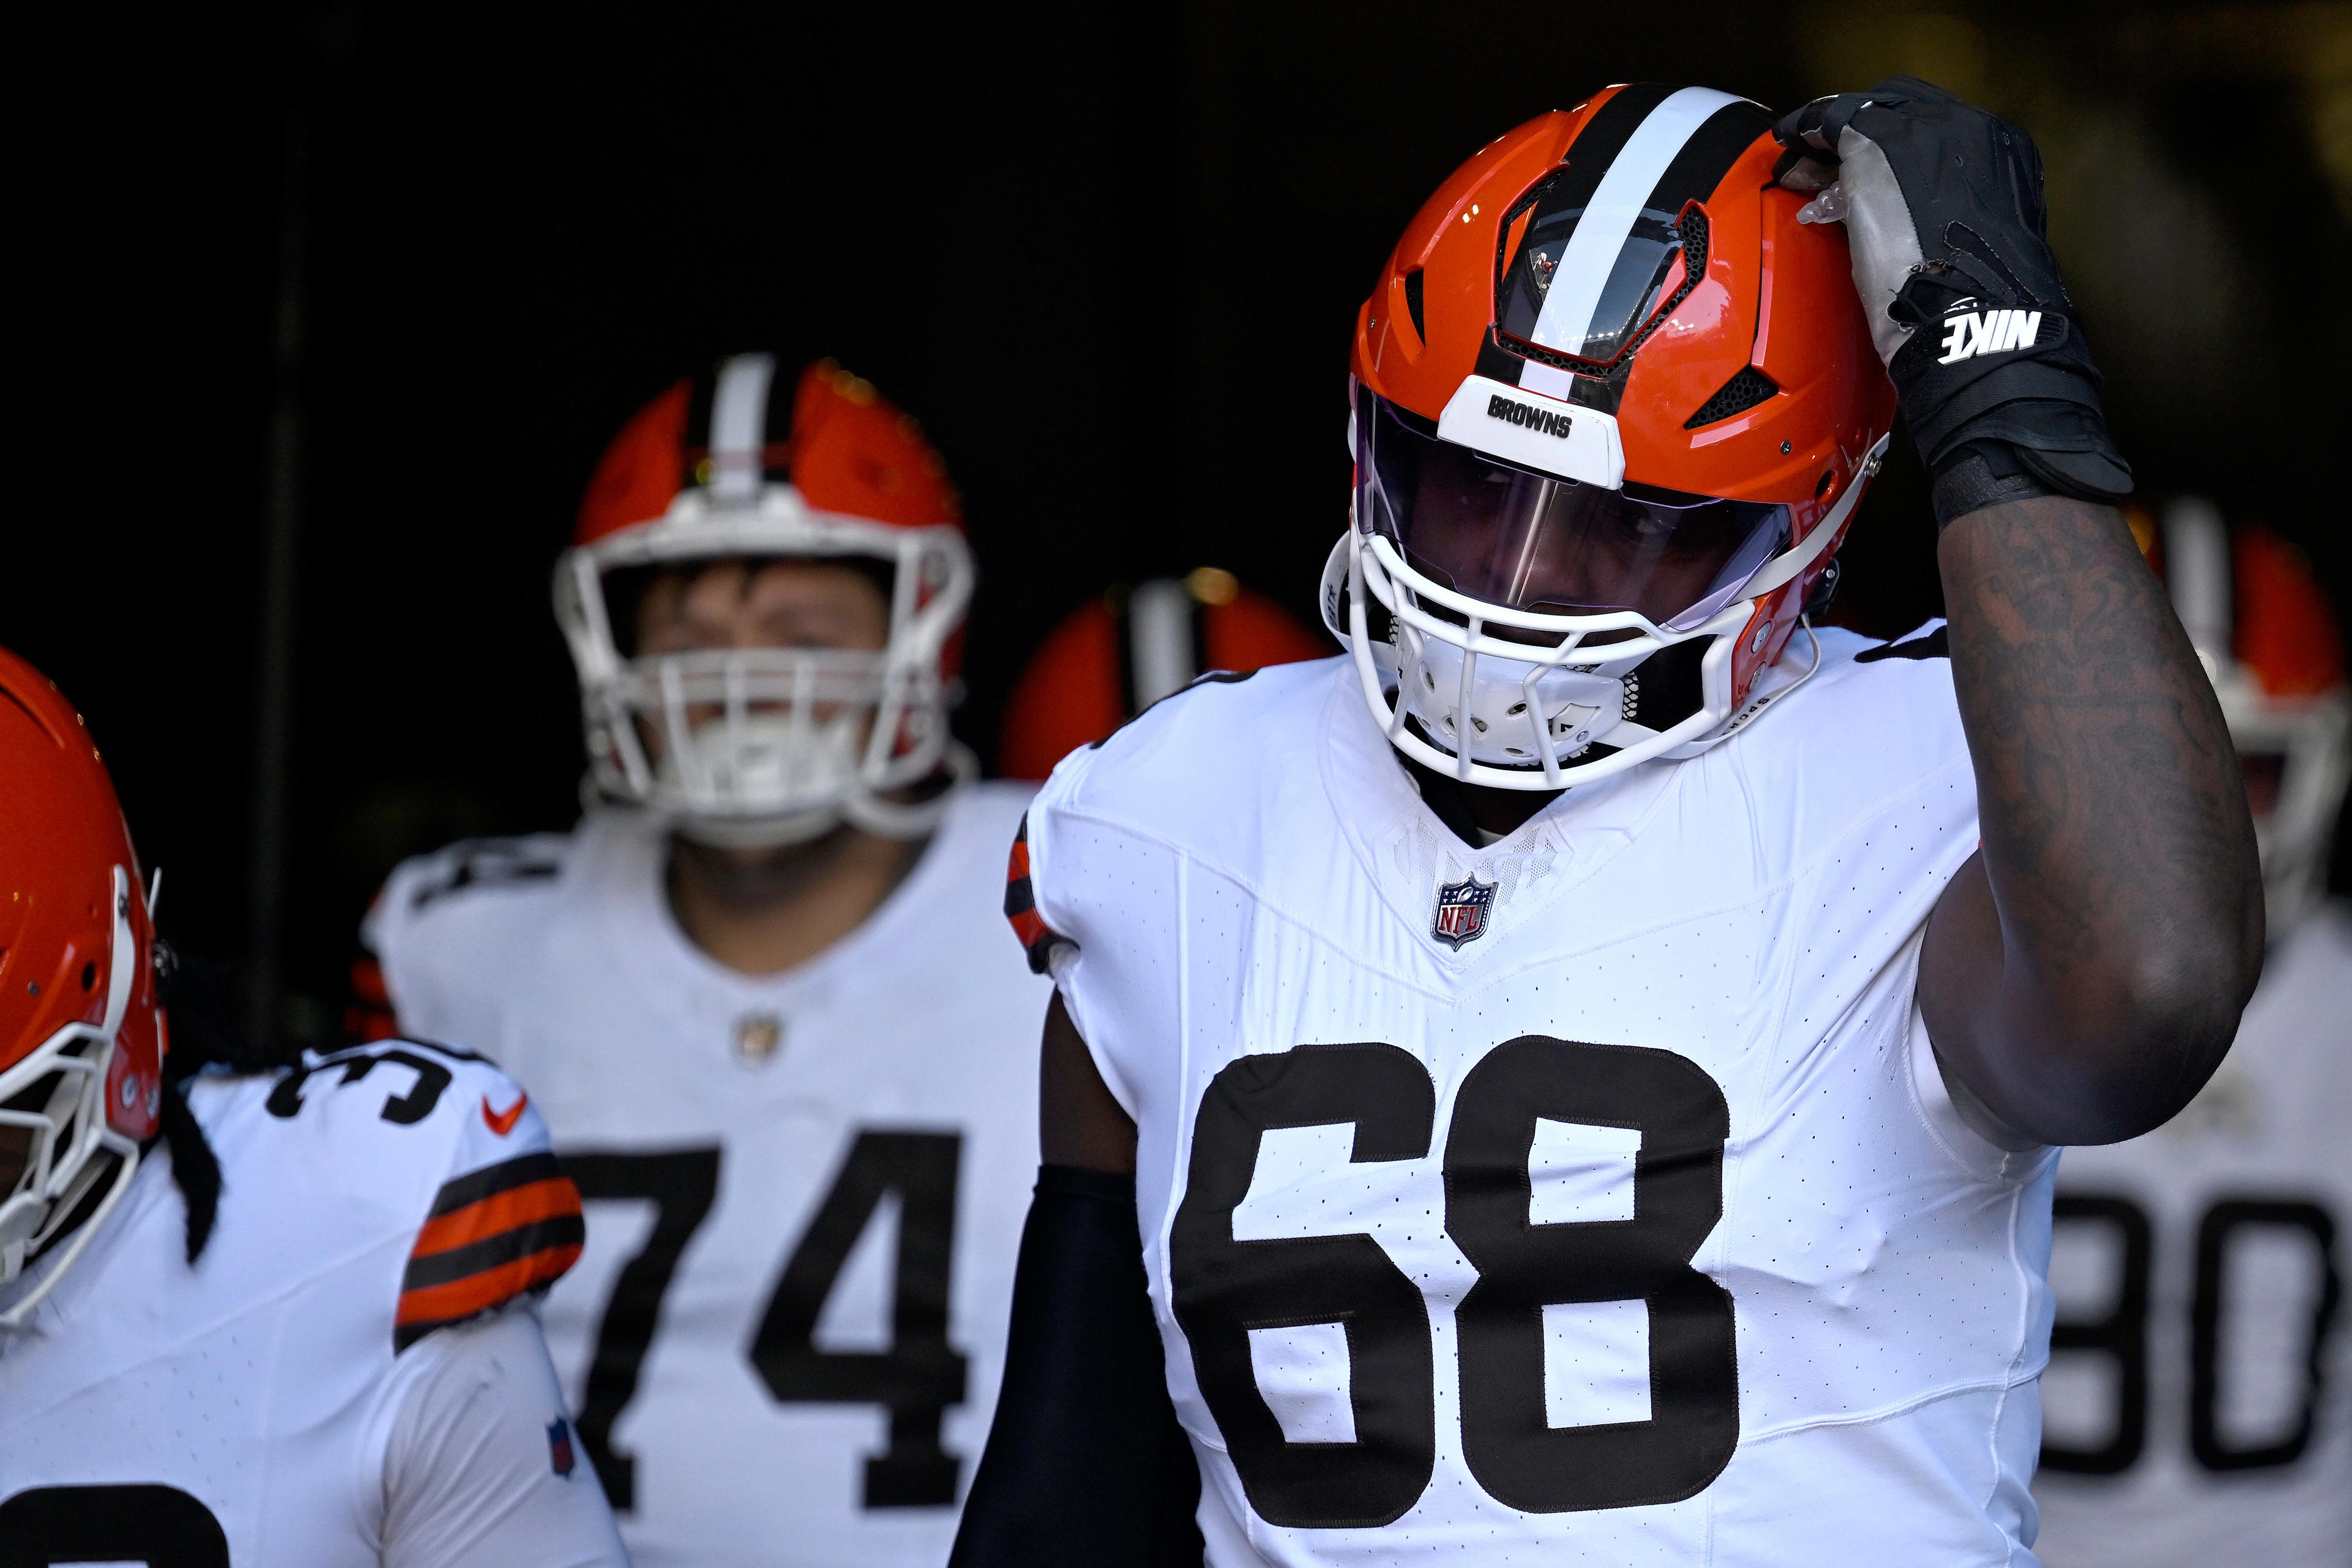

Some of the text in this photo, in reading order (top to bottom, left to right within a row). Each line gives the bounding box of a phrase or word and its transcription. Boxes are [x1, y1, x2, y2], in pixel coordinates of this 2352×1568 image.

[1937, 309, 2042, 366] NIKE
[1487, 394, 1572, 439] BROWNS
[1438, 906, 1479, 935] NFL
[1170, 1034, 1740, 1528] 68
[558, 1127, 969, 1513] 74
